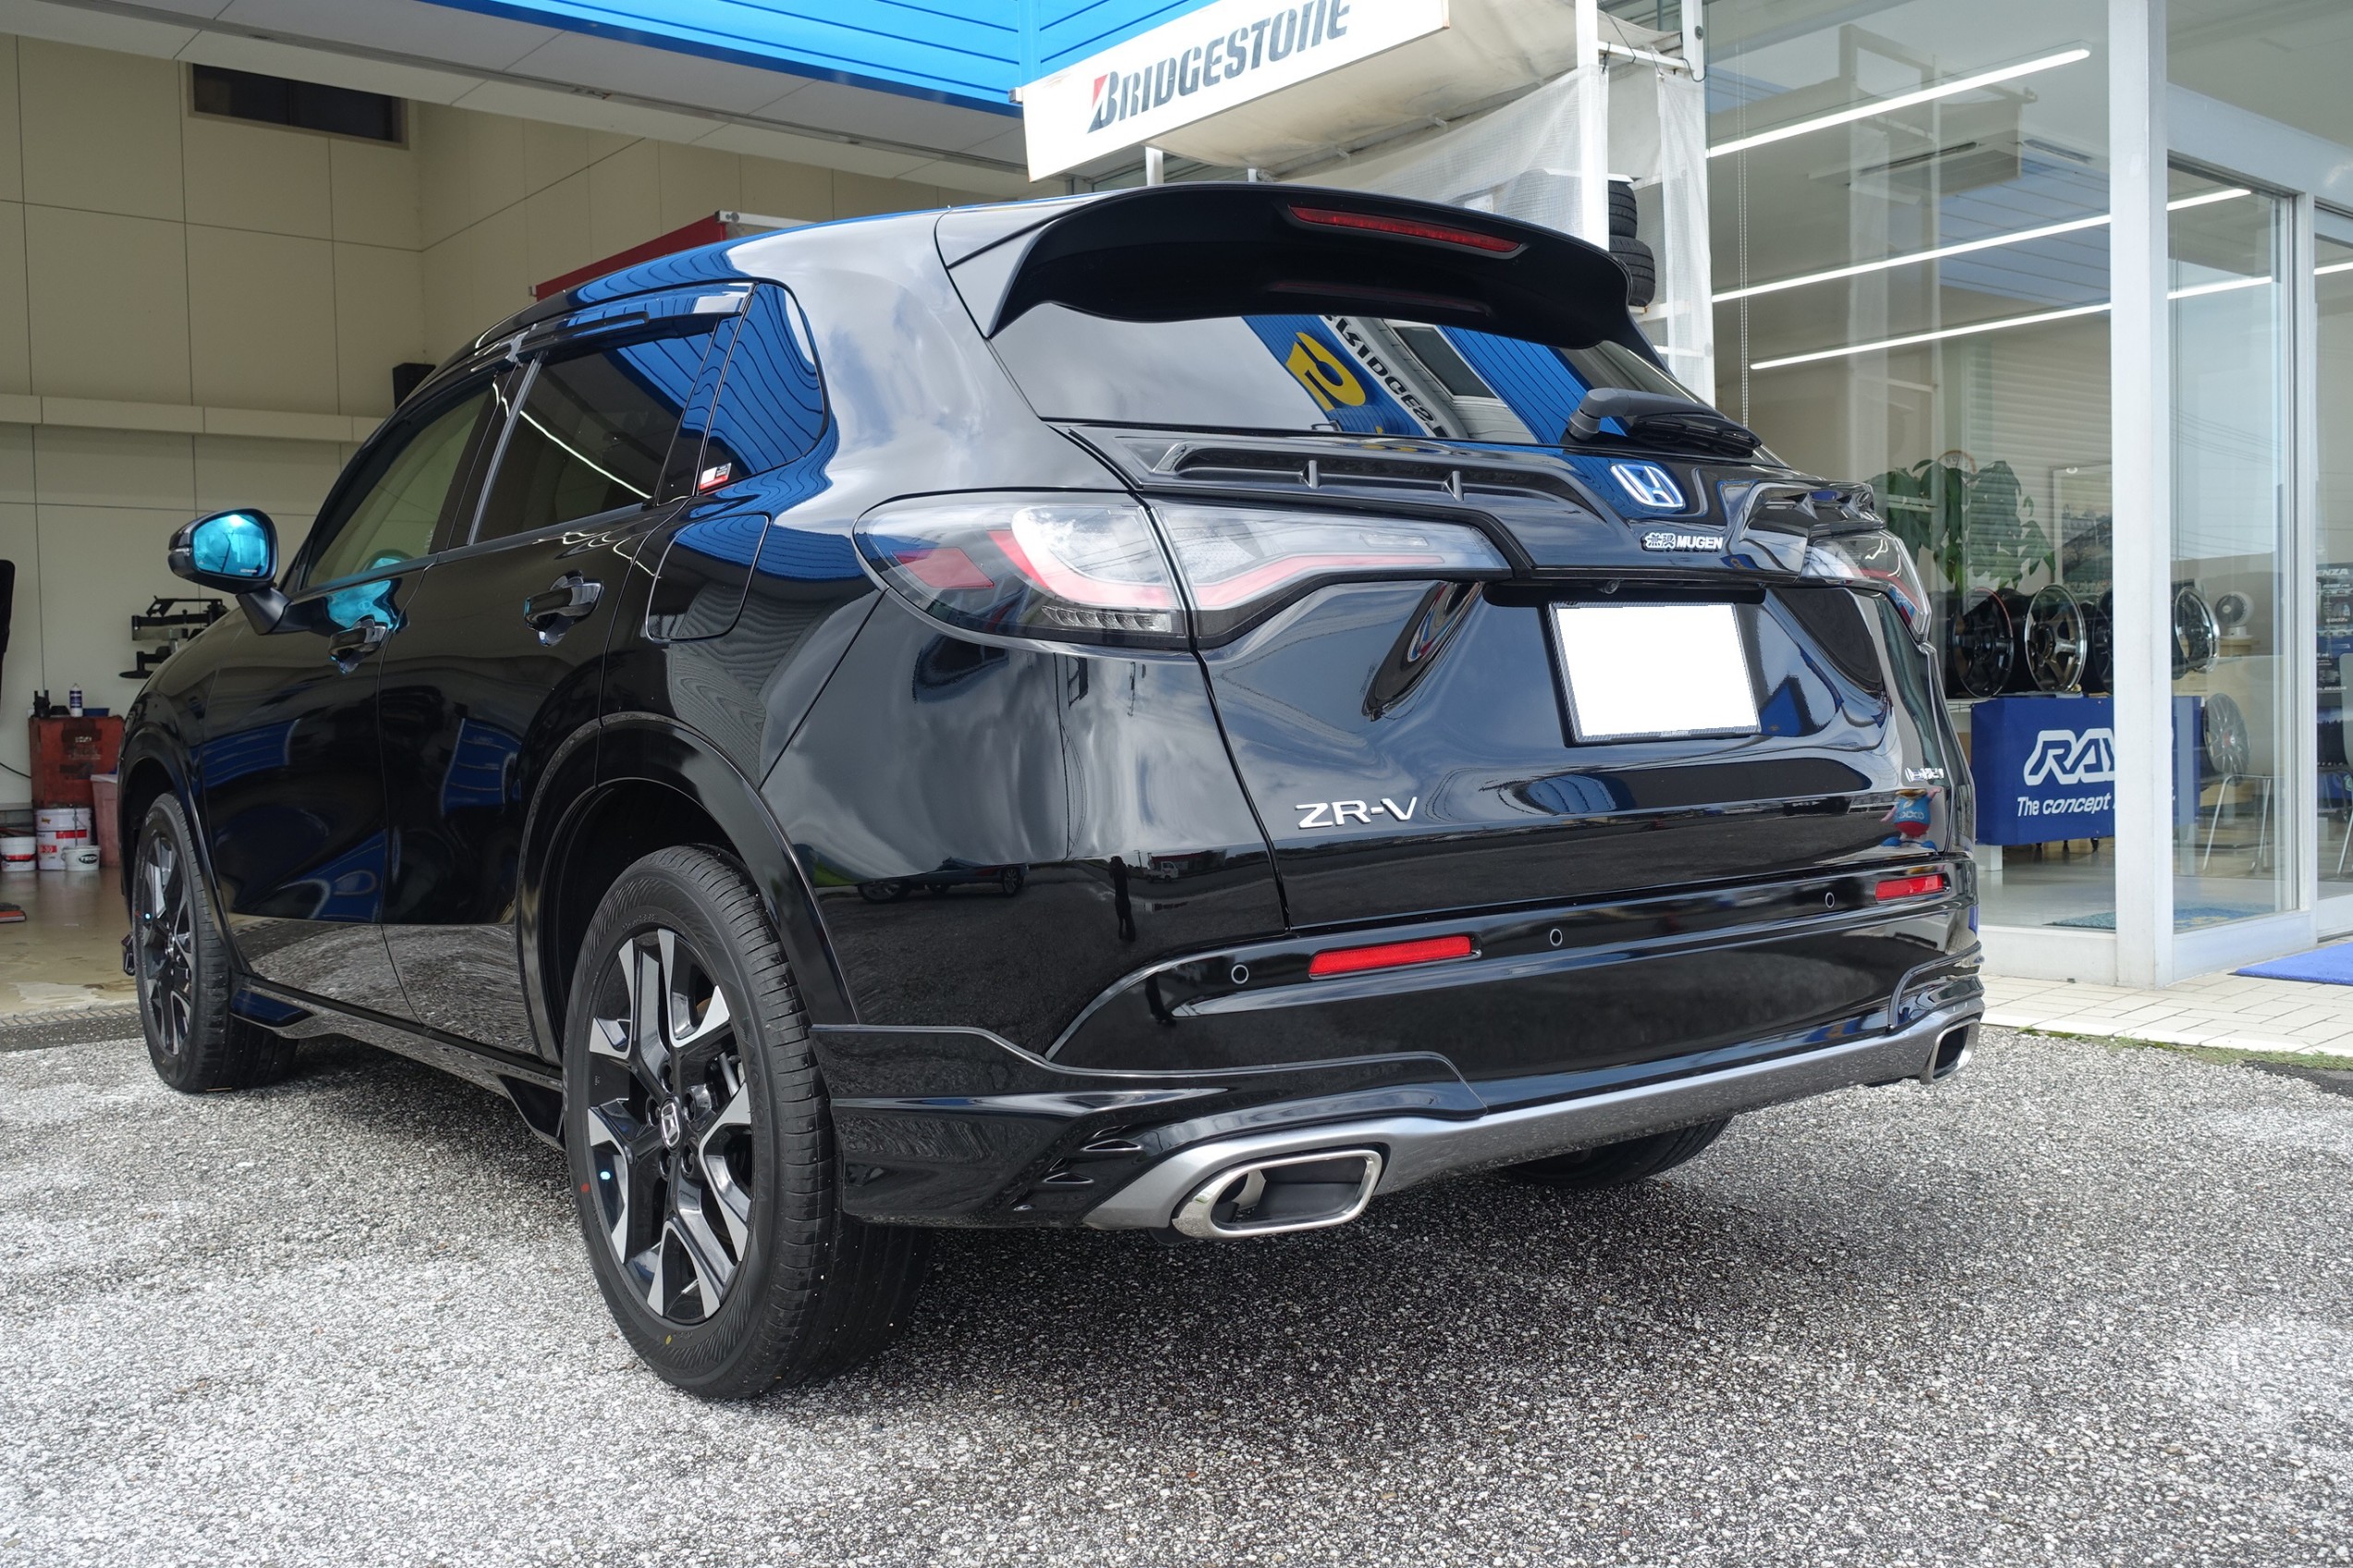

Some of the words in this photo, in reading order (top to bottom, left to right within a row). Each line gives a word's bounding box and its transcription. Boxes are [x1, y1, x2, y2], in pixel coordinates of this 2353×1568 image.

[1087, 0, 1351, 134] BRIDGESTONE
[1676, 535, 1724, 550] MUGEN
[2023, 727, 2115, 786] RA
[1295, 796, 1418, 830] ZR-V
[2017, 796, 2040, 817] The
[2042, 792, 2112, 814] concept
